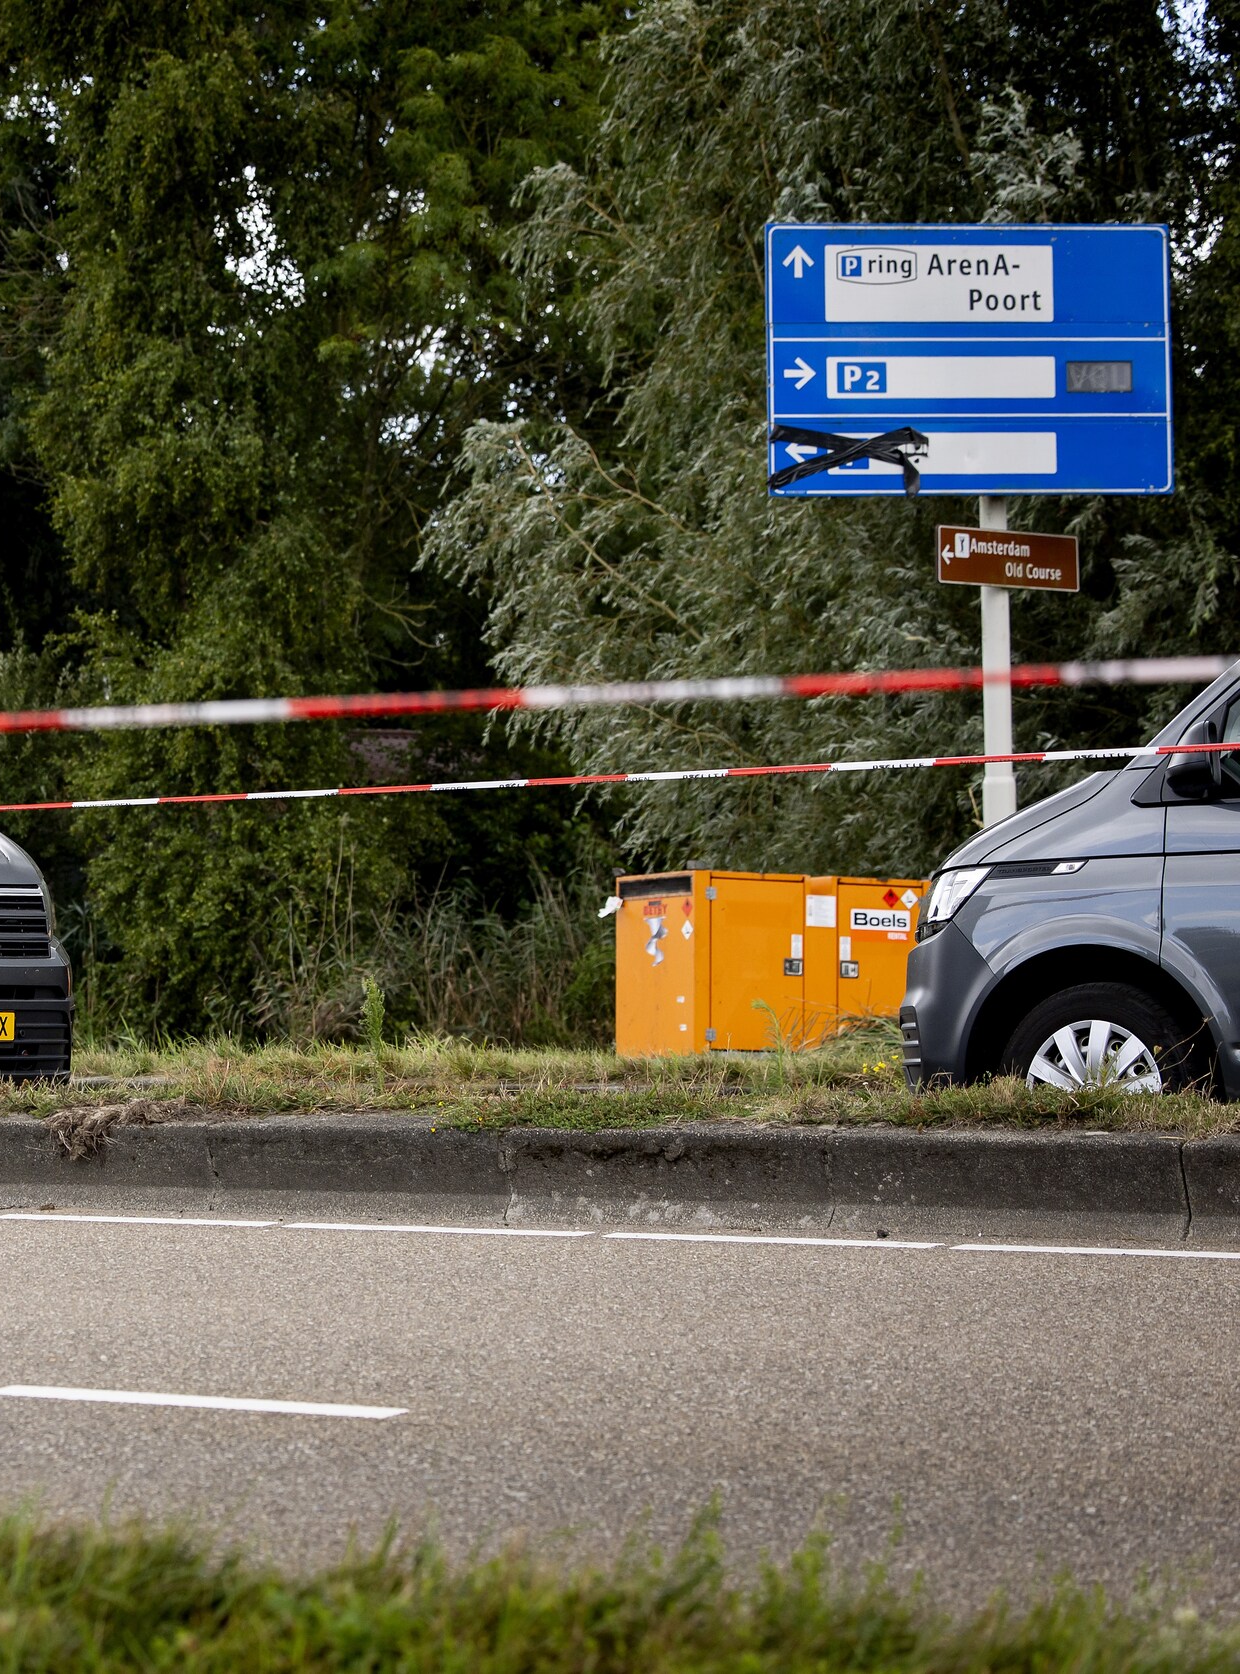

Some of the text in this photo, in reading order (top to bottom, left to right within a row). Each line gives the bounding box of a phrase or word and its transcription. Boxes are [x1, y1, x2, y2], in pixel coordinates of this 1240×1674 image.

[868, 255, 912, 278] ring
[927, 254, 1020, 276] ArenA-
[969, 289, 1041, 311] Poort
[844, 365, 880, 391] P2
[970, 538, 1031, 557] Amsterdam
[1005, 562, 1062, 580] Old Course
[854, 912, 907, 928] Boels
